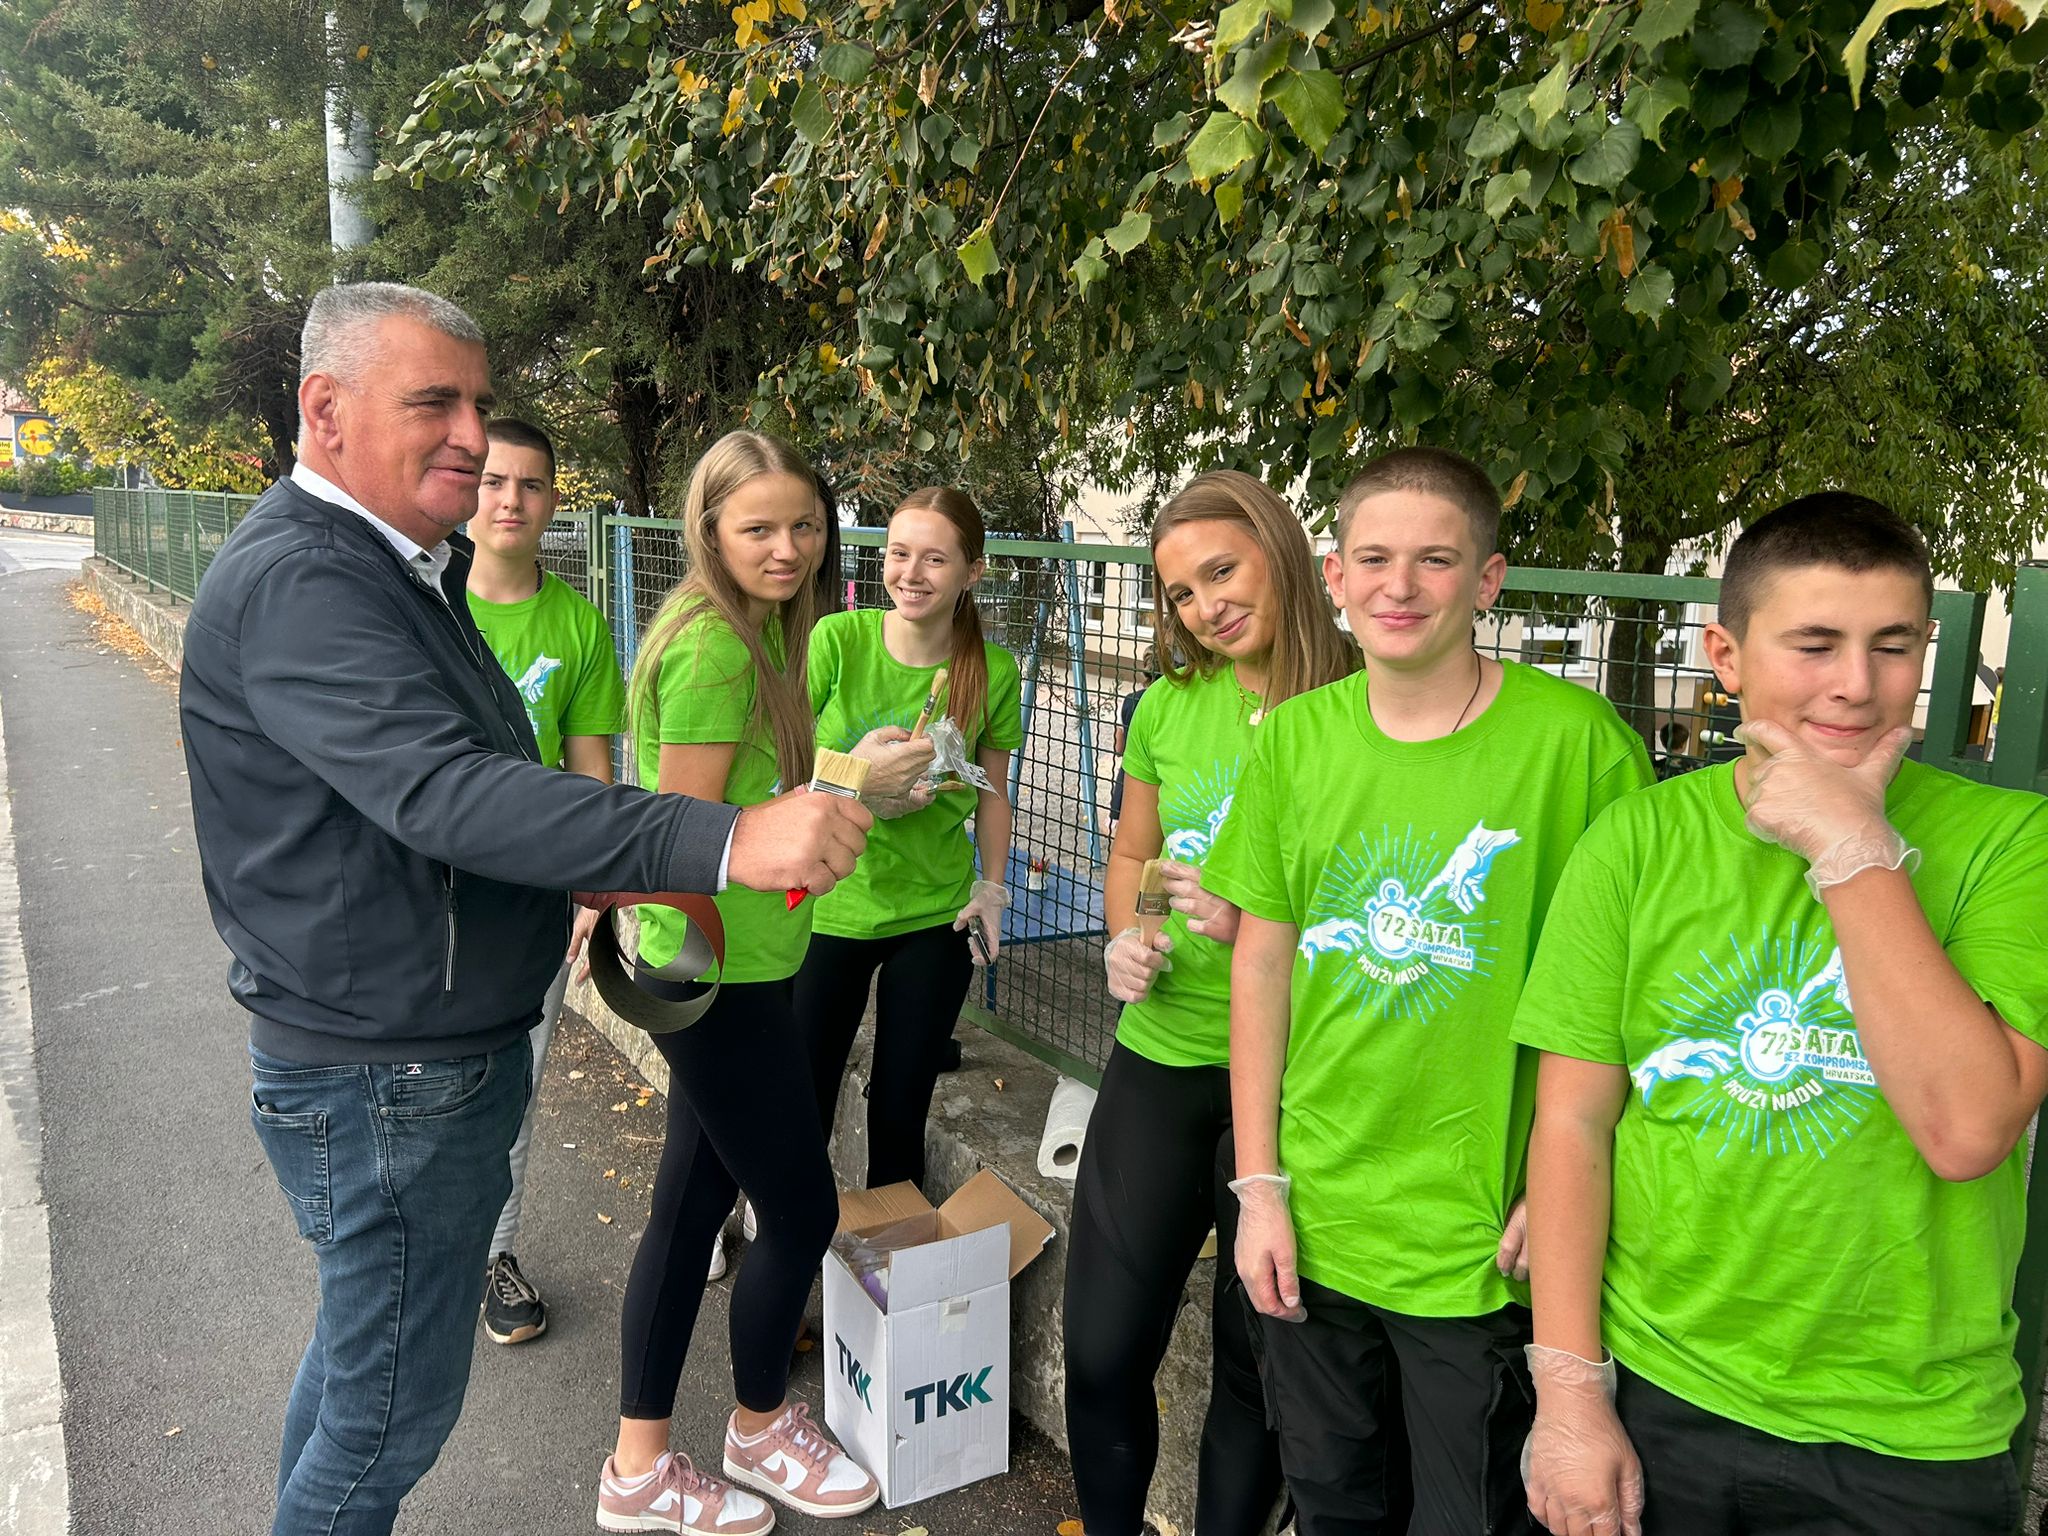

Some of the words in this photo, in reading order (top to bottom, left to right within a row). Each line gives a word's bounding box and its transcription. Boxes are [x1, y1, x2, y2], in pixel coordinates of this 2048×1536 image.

[1380, 911, 1406, 937] 72
[1408, 919, 1462, 948] SATA
[1405, 938, 1416, 948] BEZ
[1417, 941, 1472, 960] KOMPROMISA
[1433, 954, 1471, 968] HRVATSKA
[1357, 953, 1393, 985] PRUŽI
[1393, 961, 1429, 986] NADU
[1760, 1030, 1787, 1057] 72
[1788, 1027, 1859, 1059] SATA
[1784, 1051, 1800, 1062] BEZ
[1825, 1069, 1873, 1083] HRVATSKA
[1722, 1079, 1768, 1110] PRUŽI
[1771, 1079, 1823, 1111] NADU
[835, 1332, 872, 1414] TKK
[904, 1365, 994, 1425] TKK
